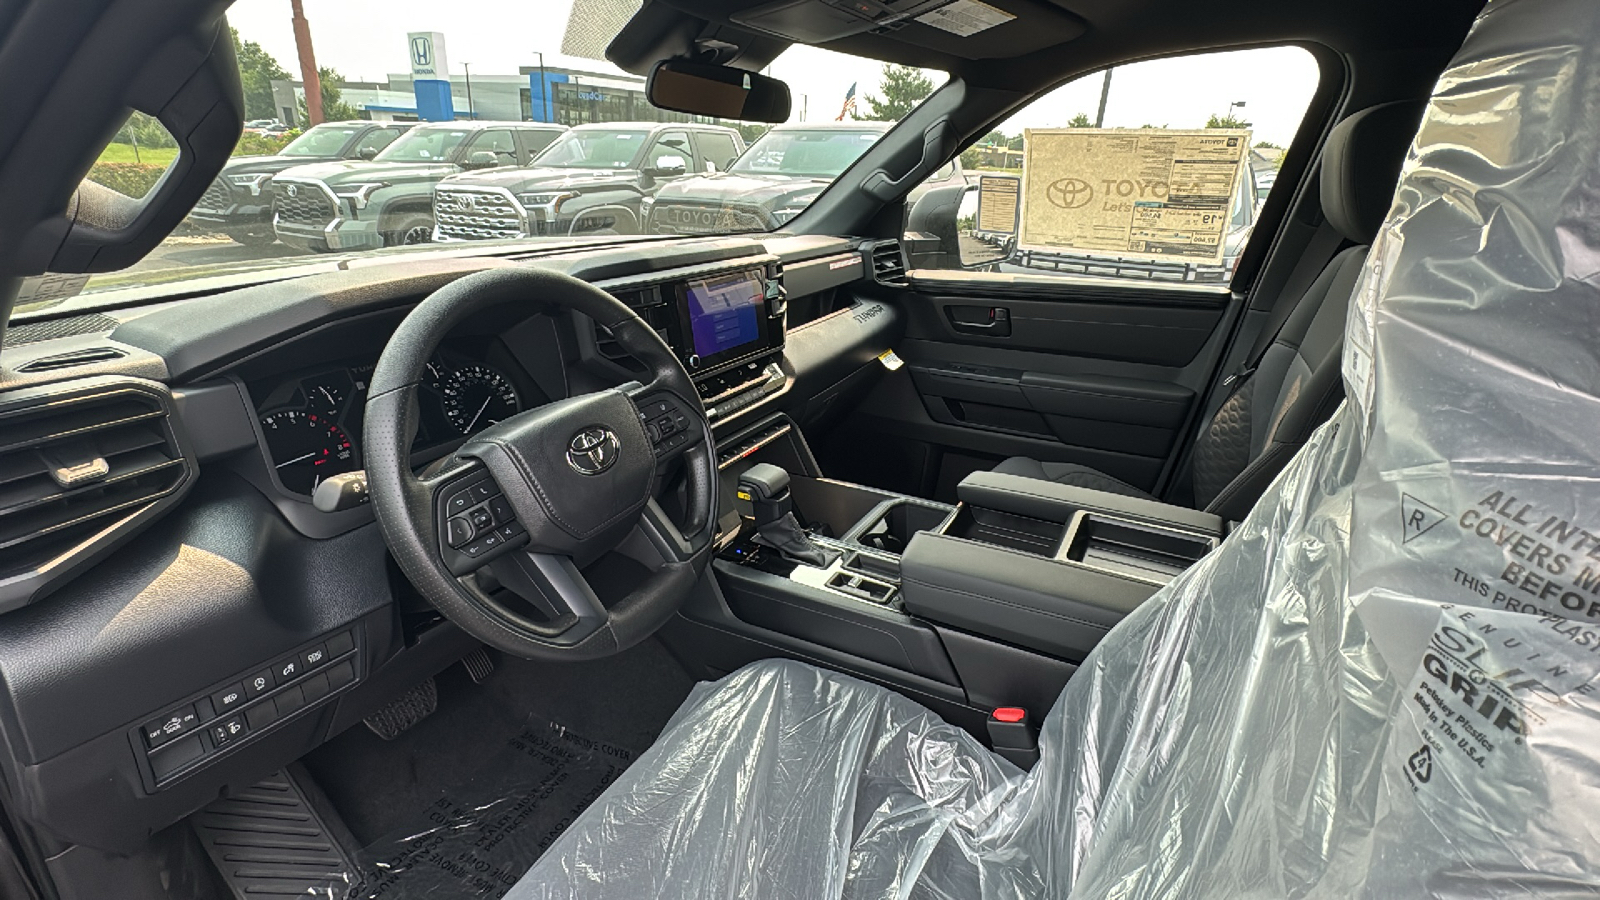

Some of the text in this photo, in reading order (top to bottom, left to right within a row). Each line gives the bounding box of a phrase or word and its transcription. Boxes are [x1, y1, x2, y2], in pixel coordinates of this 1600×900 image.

[1102, 202, 1133, 213] Let's
[1408, 509, 1425, 531] R
[1478, 490, 1533, 526] ALL
[1459, 509, 1571, 576] COVERS
[1454, 567, 1490, 597] THIS
[1423, 652, 1533, 736] GRIP
[1413, 692, 1485, 769] Made In The U.S.A.
[1420, 681, 1495, 752] Petoskey Plastics
[149, 729, 161, 738] OFF
[601, 744, 631, 761] COVER
[1417, 757, 1427, 769] 4
[540, 771, 570, 800] COVER
[537, 817, 571, 849] COVER
